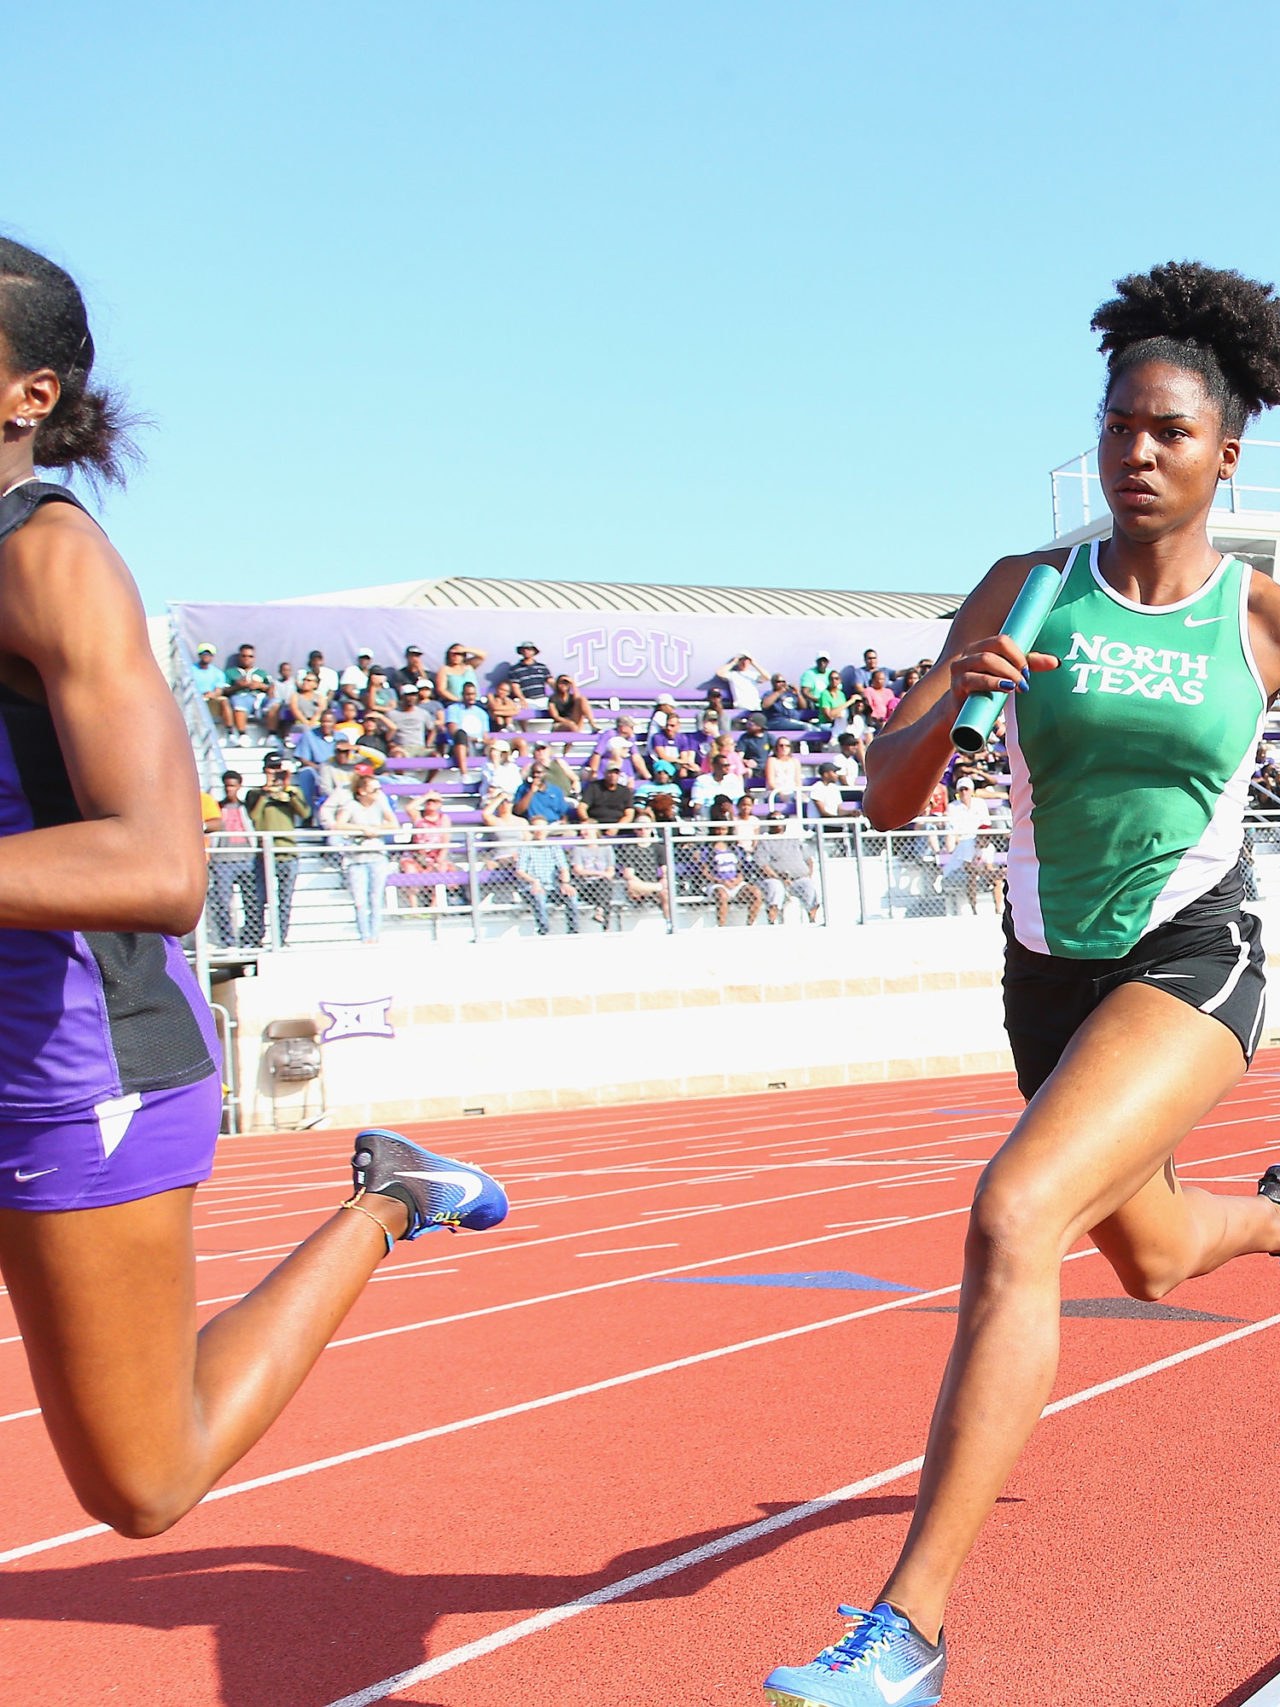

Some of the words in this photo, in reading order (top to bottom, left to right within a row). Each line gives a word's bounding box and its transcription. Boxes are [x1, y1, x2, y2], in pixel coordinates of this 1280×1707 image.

[563, 626, 692, 688] TCU
[1064, 632, 1209, 679] NORTH
[1069, 663, 1205, 705] TEXAS
